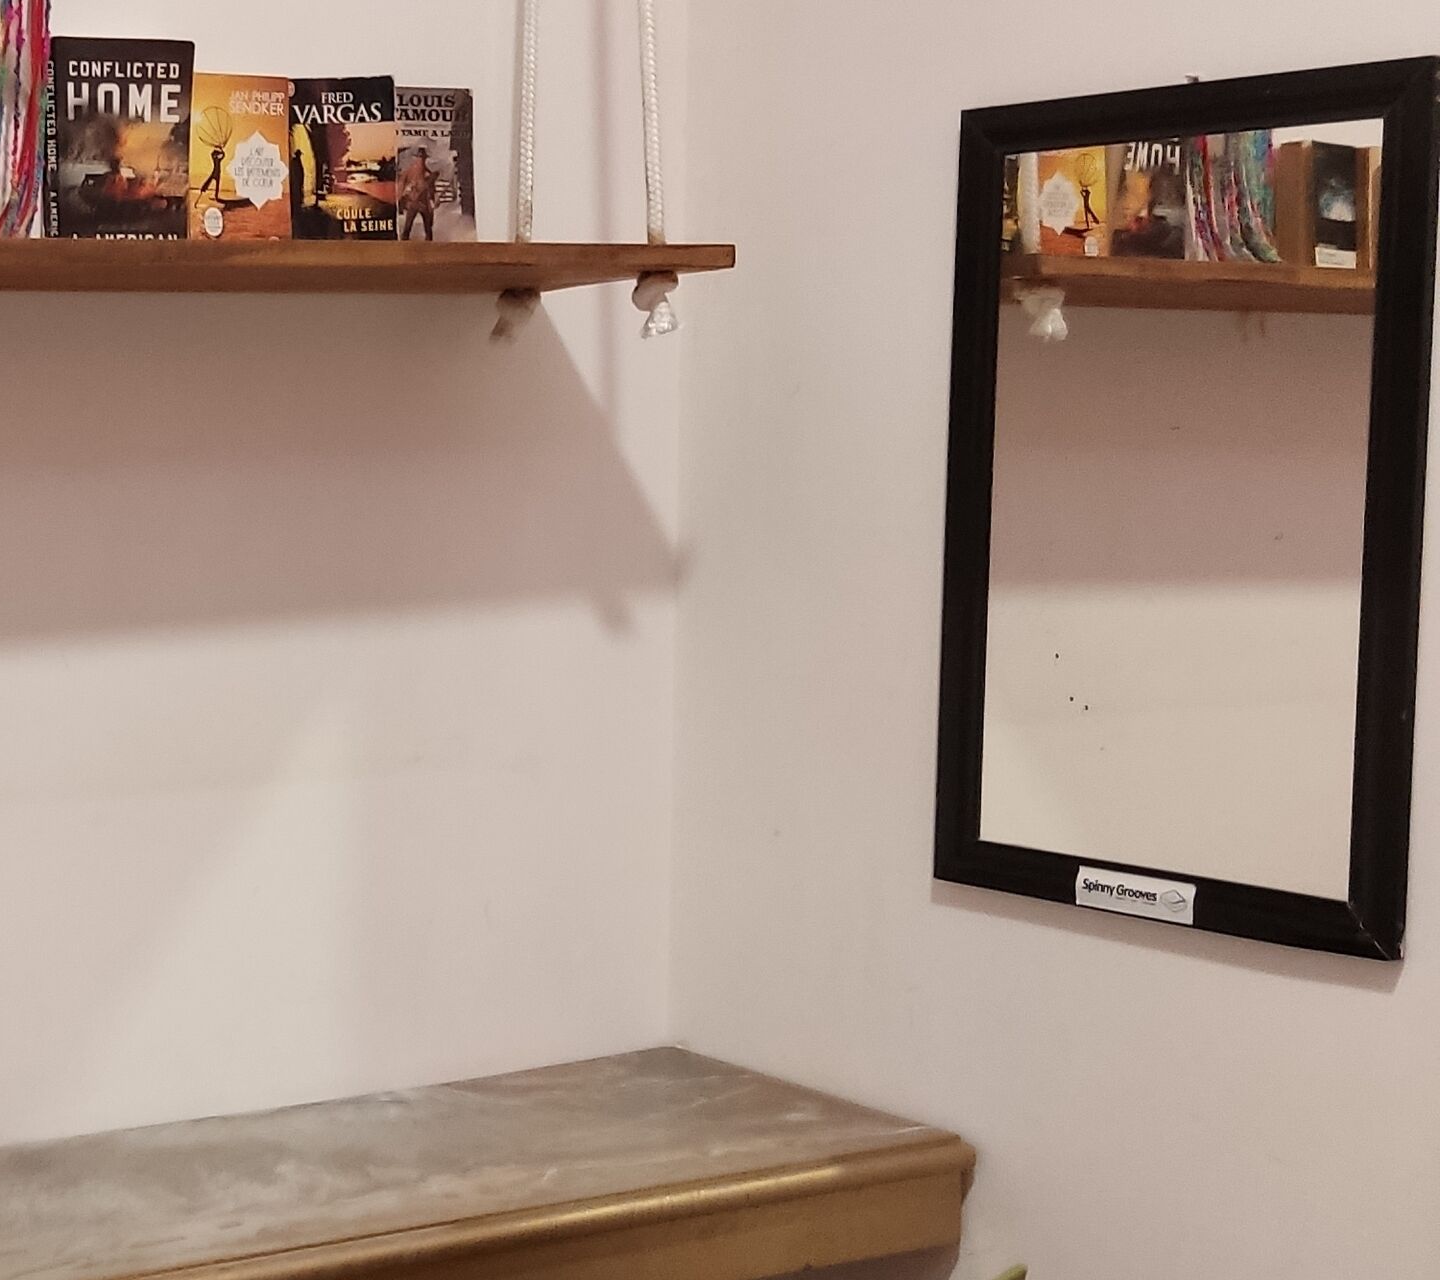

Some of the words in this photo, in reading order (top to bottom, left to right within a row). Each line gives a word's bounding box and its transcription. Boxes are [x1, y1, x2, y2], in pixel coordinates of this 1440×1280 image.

[68, 60, 180, 78] CONFLICTED
[47, 61, 56, 136] CONFLICTED
[67, 81, 181, 123] HOME
[321, 91, 354, 104] FRED
[396, 94, 455, 108] LOUIS
[229, 101, 285, 116] SENDKER
[292, 102, 382, 124] VARGAS
[396, 108, 457, 122] 'AMOU
[47, 139, 57, 172] HOME
[49, 201, 59, 237] AMERIC
[336, 208, 372, 220] COULE
[343, 220, 357, 232] LA
[361, 219, 394, 232] SEINE
[1082, 878, 1115, 896] Spinny
[1116, 884, 1158, 902] Grooves
